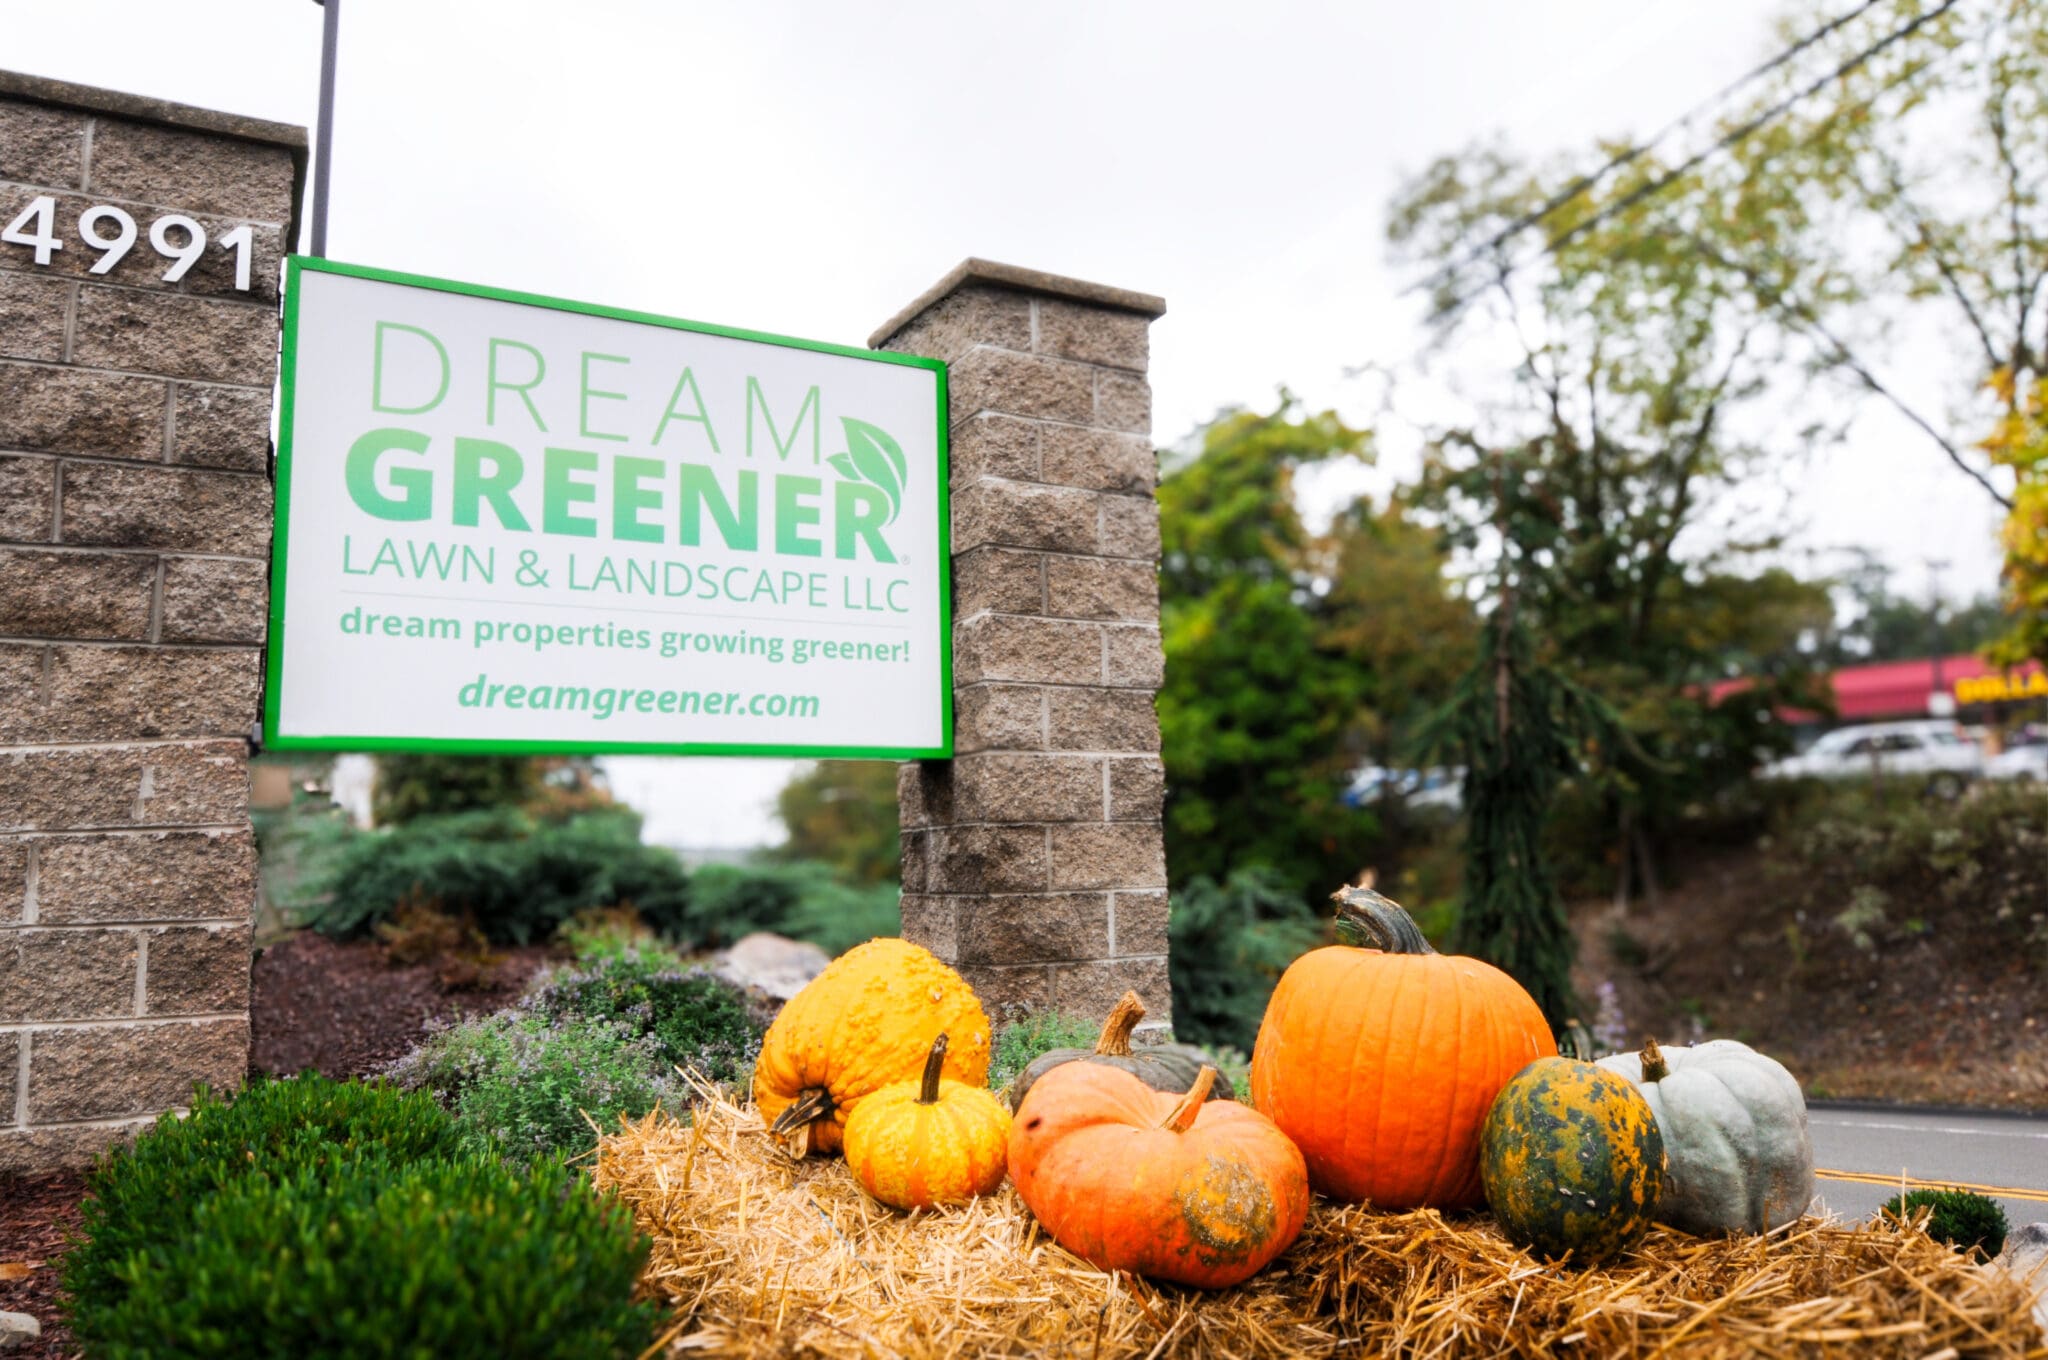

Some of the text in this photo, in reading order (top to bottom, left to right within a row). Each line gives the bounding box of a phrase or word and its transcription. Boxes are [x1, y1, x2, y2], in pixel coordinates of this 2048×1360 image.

[1, 195, 253, 291] 4991
[371, 319, 821, 466] DREAM
[344, 427, 899, 565] GREENER
[342, 534, 909, 613] LAWN & LANDSCAPE LLC
[339, 606, 910, 665] dream properties growing greener!
[457, 672, 821, 722] dreamgreener.com
